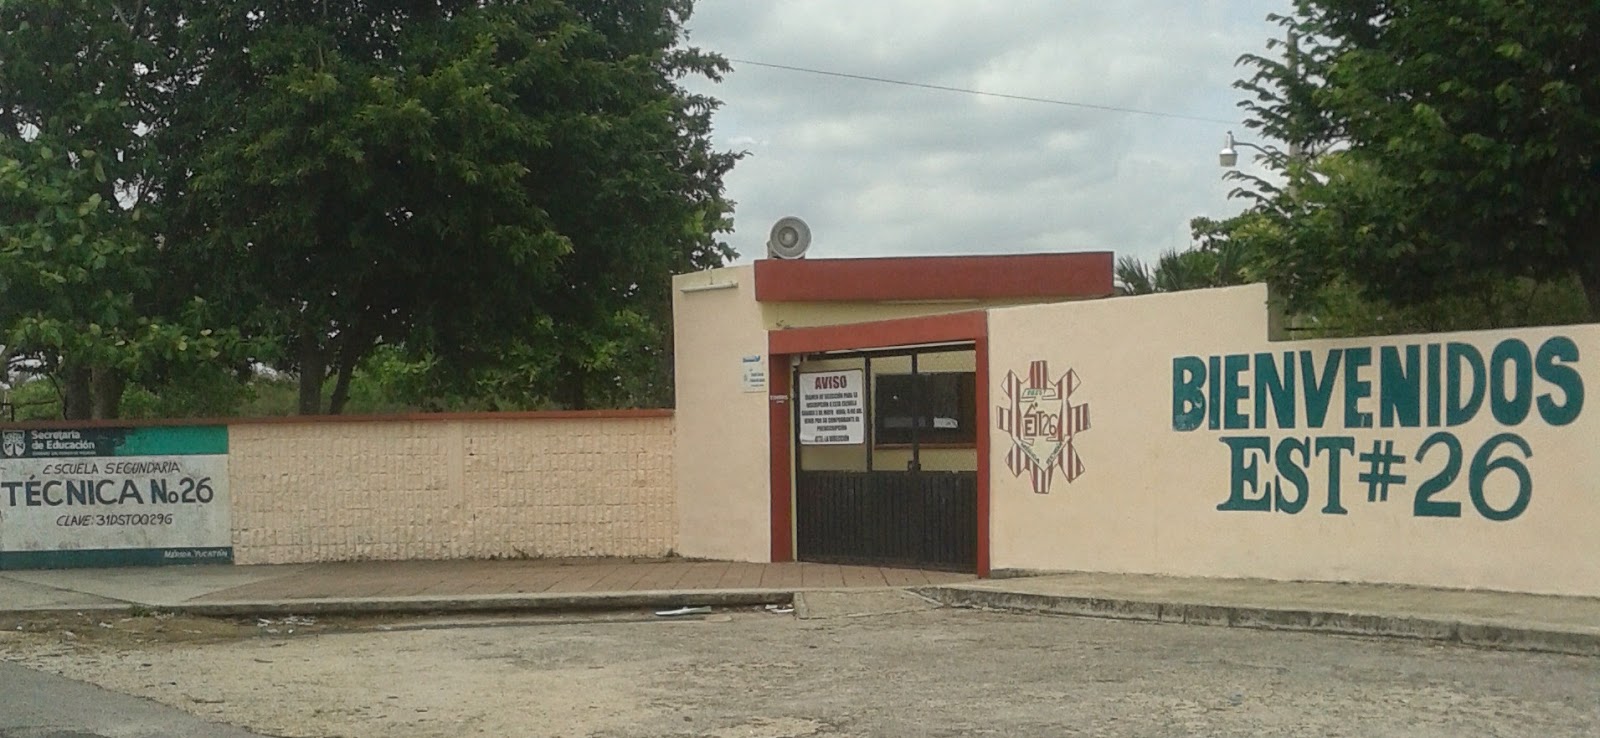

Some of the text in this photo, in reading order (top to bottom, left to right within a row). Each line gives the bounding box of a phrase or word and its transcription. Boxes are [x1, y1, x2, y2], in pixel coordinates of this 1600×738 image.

[814, 375, 848, 390] AVISO
[1172, 335, 1585, 432] BIENVENIDOS
[31, 440, 95, 450] de Educación
[43, 461, 181, 475] ESCUELA SECUNDARIA
[0, 474, 145, 507] TÉCNICA
